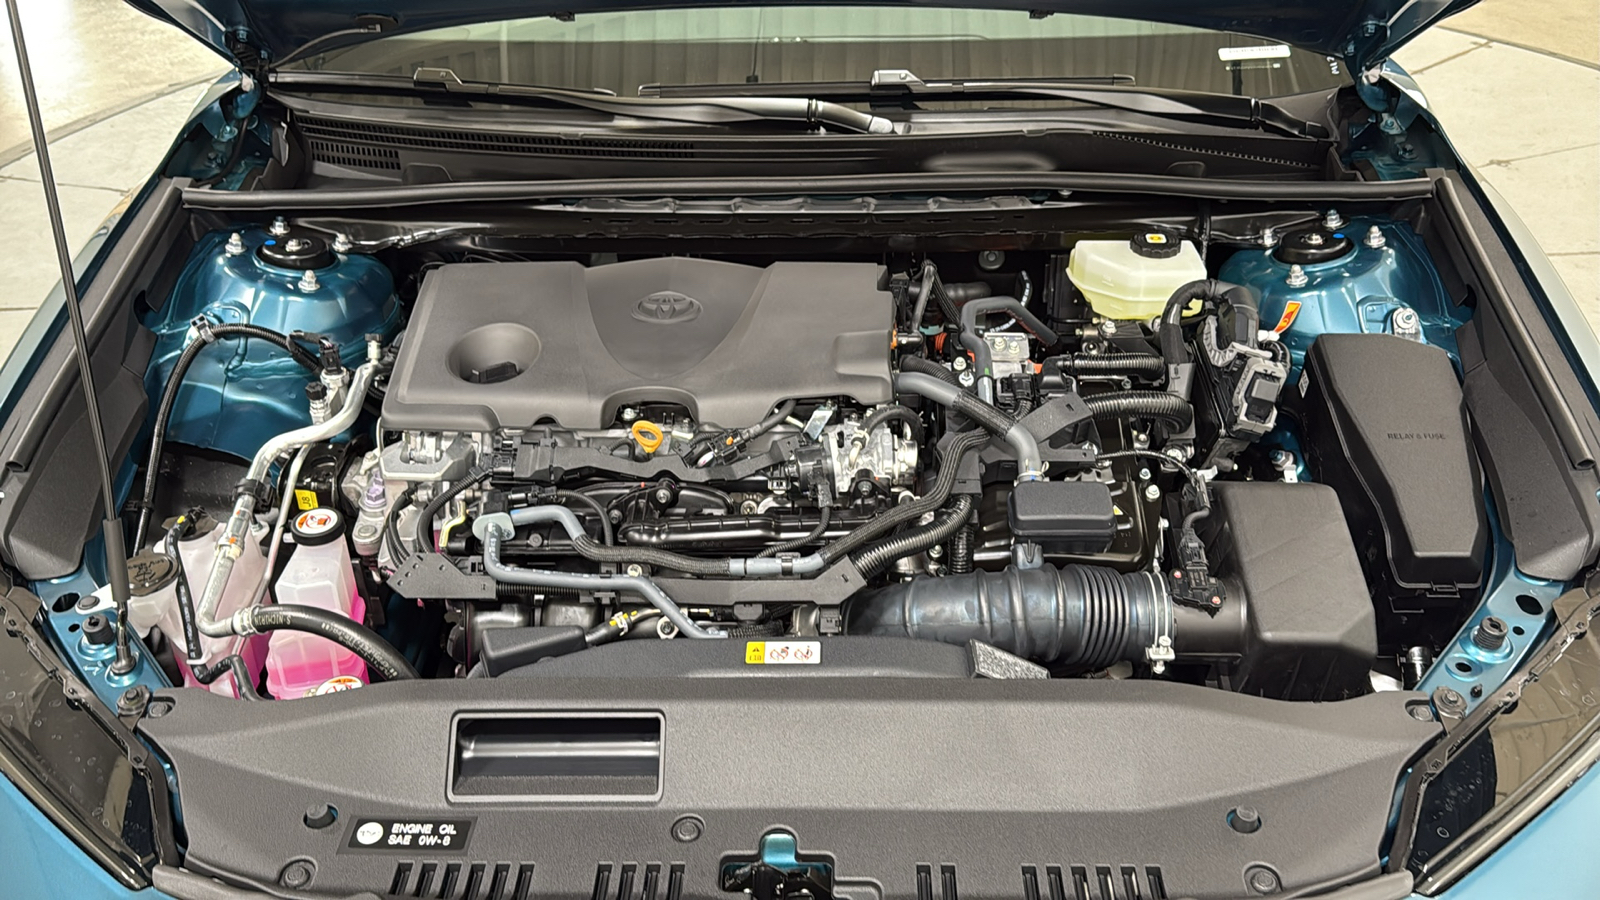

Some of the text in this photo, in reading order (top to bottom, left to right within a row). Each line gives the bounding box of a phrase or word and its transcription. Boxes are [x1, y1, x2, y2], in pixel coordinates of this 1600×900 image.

[391, 823, 434, 834] ENGINE
[439, 824, 457, 835] OIL
[387, 834, 412, 846] SAE
